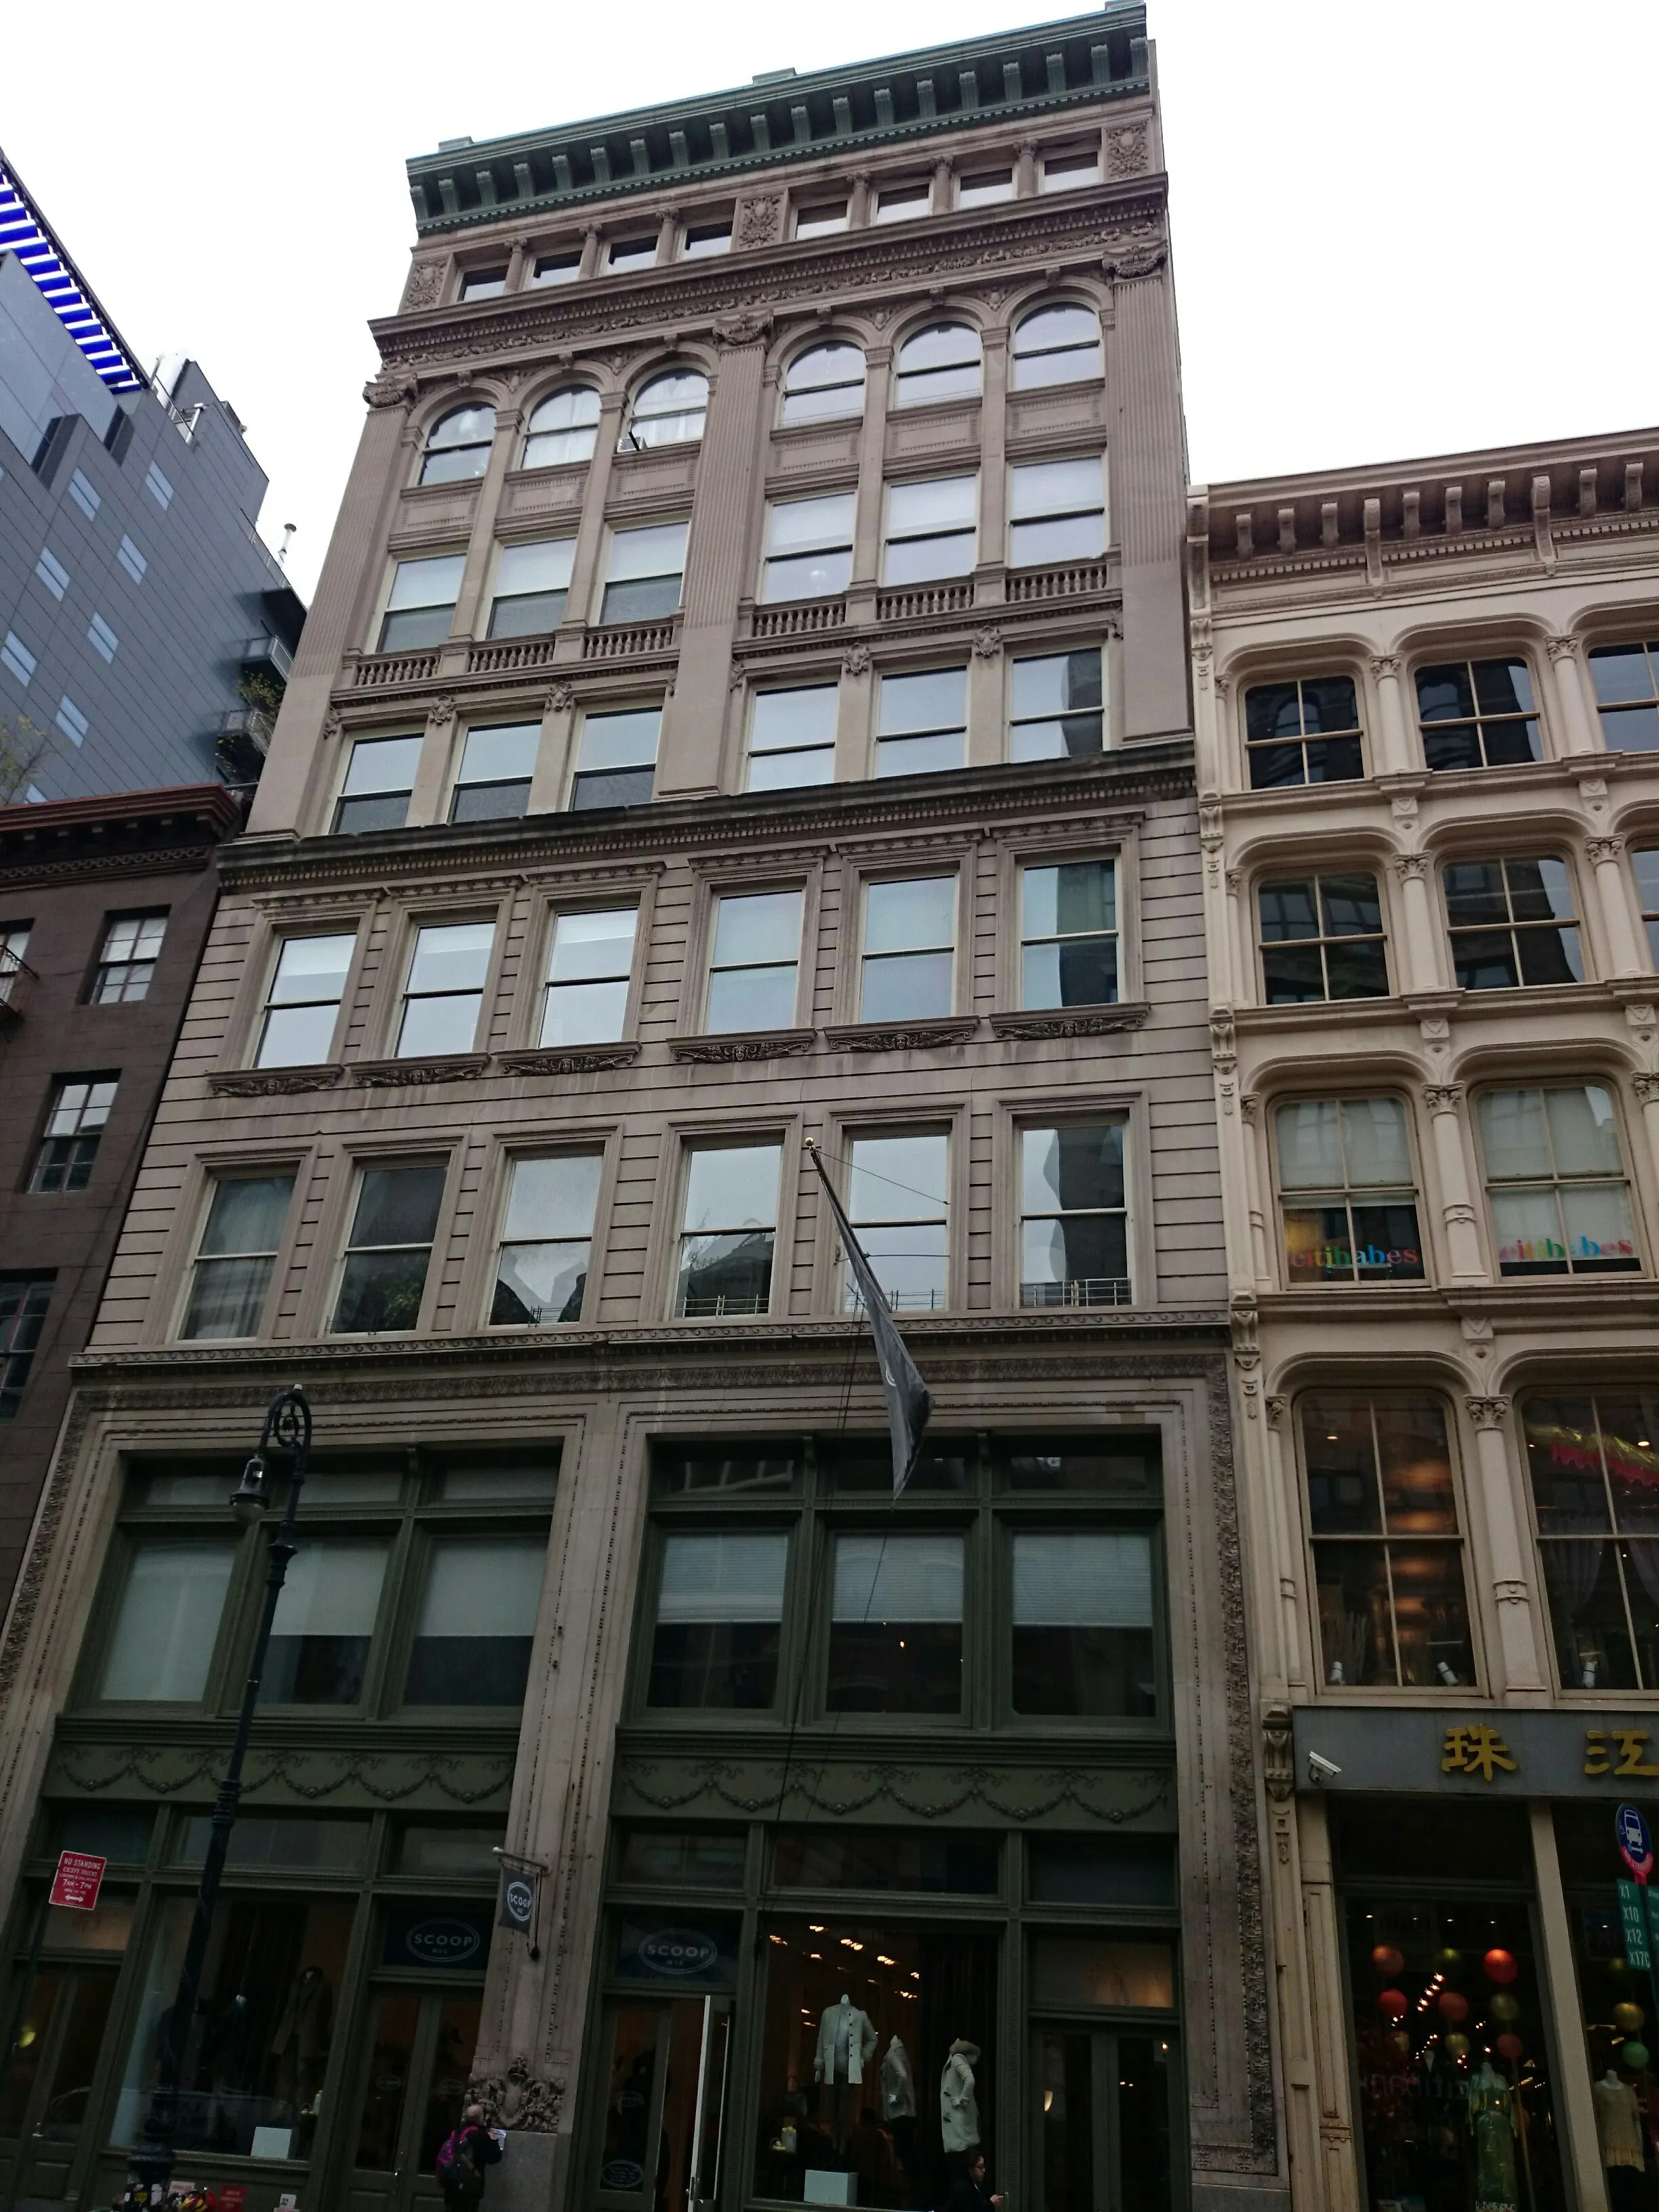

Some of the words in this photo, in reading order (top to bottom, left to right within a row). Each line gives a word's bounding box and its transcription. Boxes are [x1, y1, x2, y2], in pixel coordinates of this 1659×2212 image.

[1290, 1243, 1419, 1268] citibabes
[62, 1866, 80, 1875] EXCEPT
[73, 1859, 101, 1870] STANDING
[62, 1879, 75, 1887] 7AM
[80, 1881, 92, 1889] 7PM
[1620, 1884, 1630, 1899] X1
[510, 1893, 531, 1908] SCOOP
[1623, 1905, 1639, 1923] X10
[414, 1933, 473, 1946] SCOOP
[1626, 1927, 1643, 1944] X12
[646, 1944, 710, 1958] SCOOP
